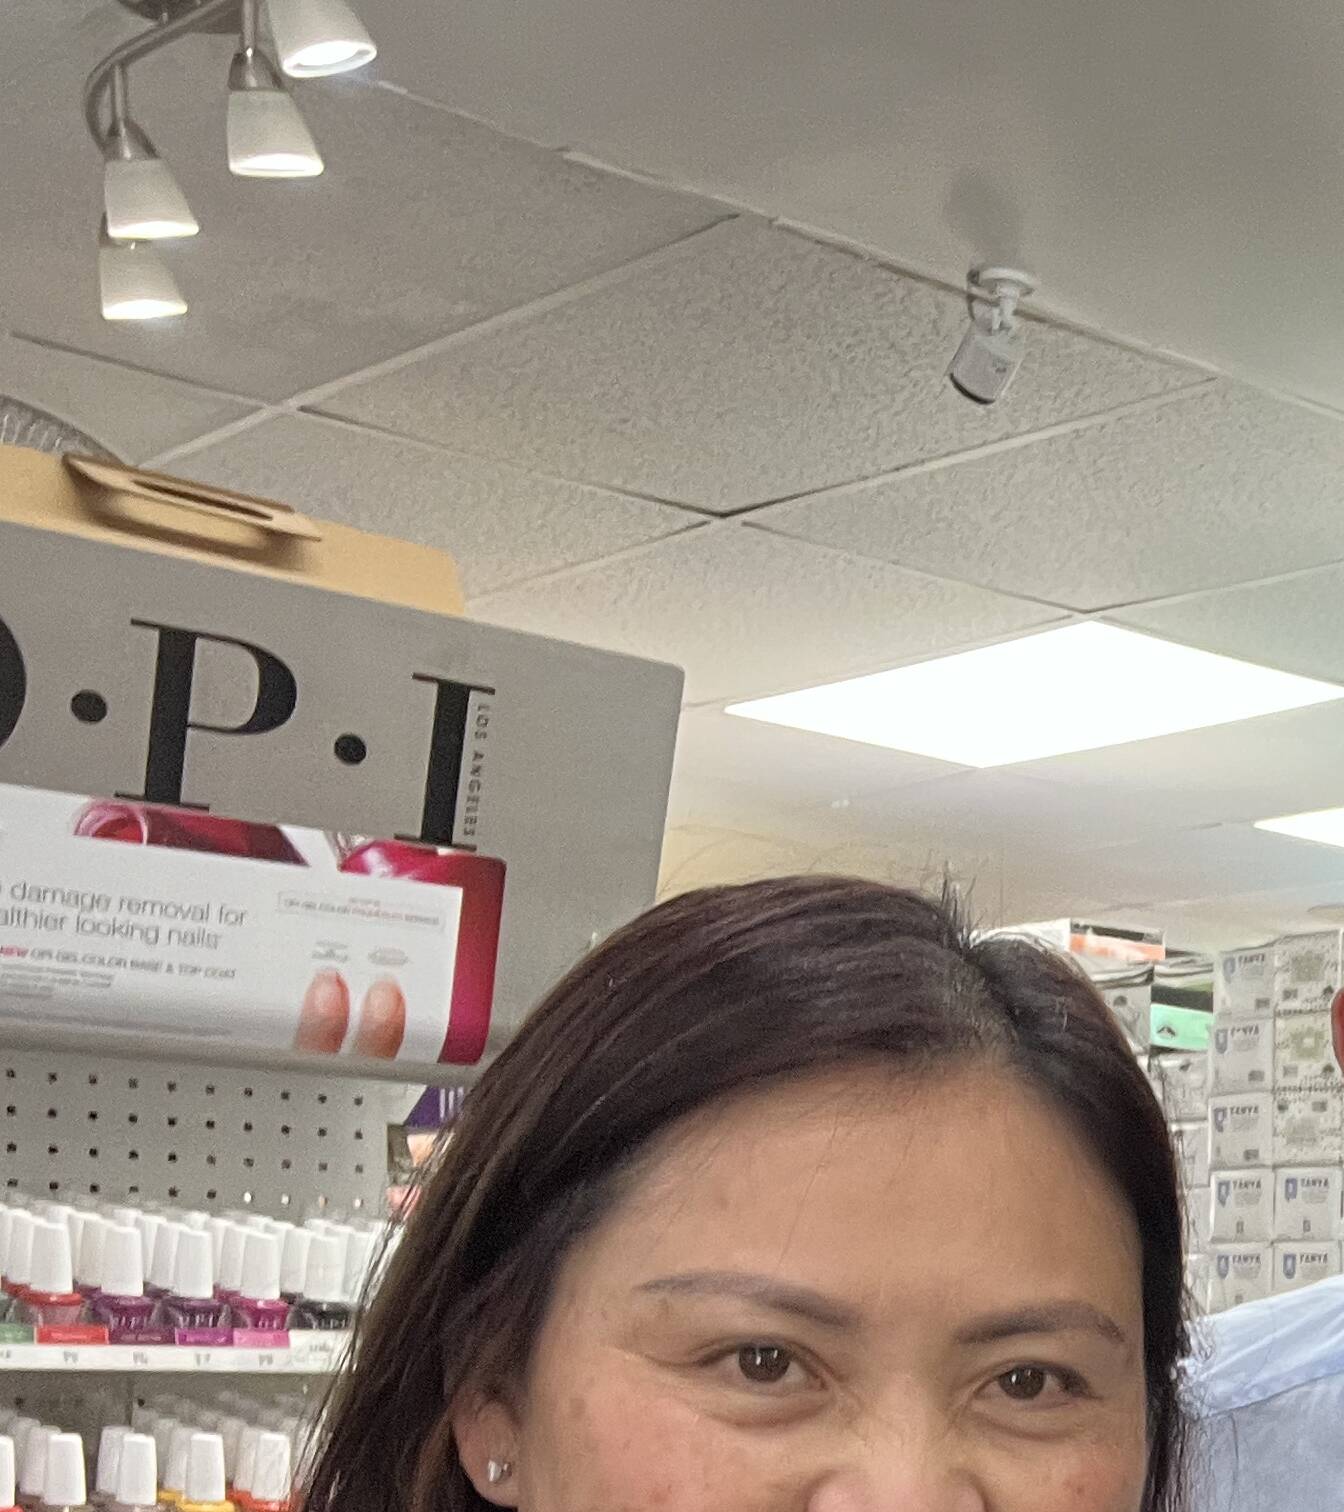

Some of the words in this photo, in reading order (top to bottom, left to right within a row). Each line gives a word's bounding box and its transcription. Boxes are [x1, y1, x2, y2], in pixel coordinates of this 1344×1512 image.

[10, 881, 112, 913] damage
[119, 895, 210, 923] removal
[218, 904, 248, 927] for
[75, 914, 160, 946] looking
[168, 928, 223, 950] nails
